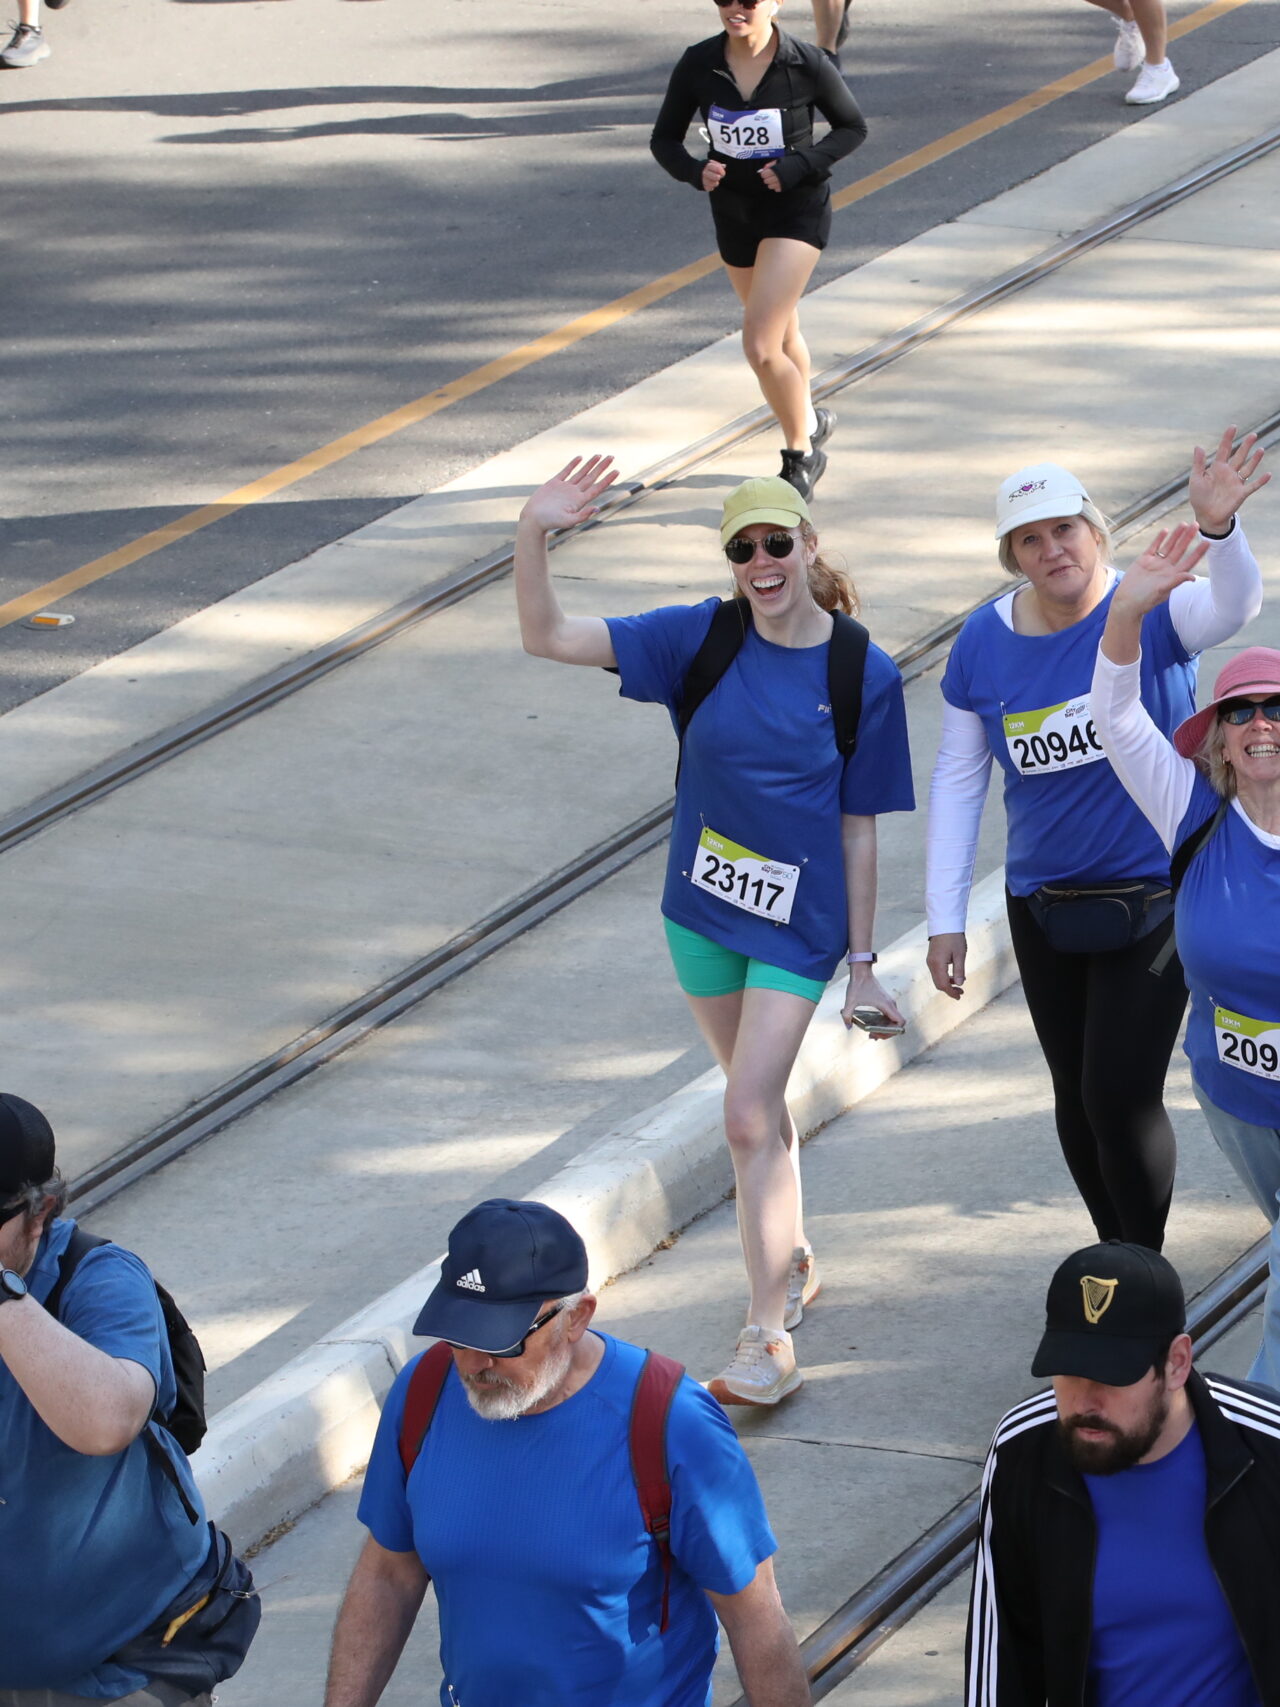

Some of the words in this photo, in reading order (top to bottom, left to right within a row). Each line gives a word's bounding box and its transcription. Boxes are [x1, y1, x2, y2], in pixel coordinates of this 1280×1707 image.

[720, 125, 770, 146] 5128
[1008, 721, 1024, 729] 12KM
[1013, 720, 1104, 768] 20946
[707, 837, 724, 850] 12KM
[701, 855, 785, 911] 23117
[1222, 1017, 1241, 1028] 12KM
[456, 1279, 486, 1293] adidas
